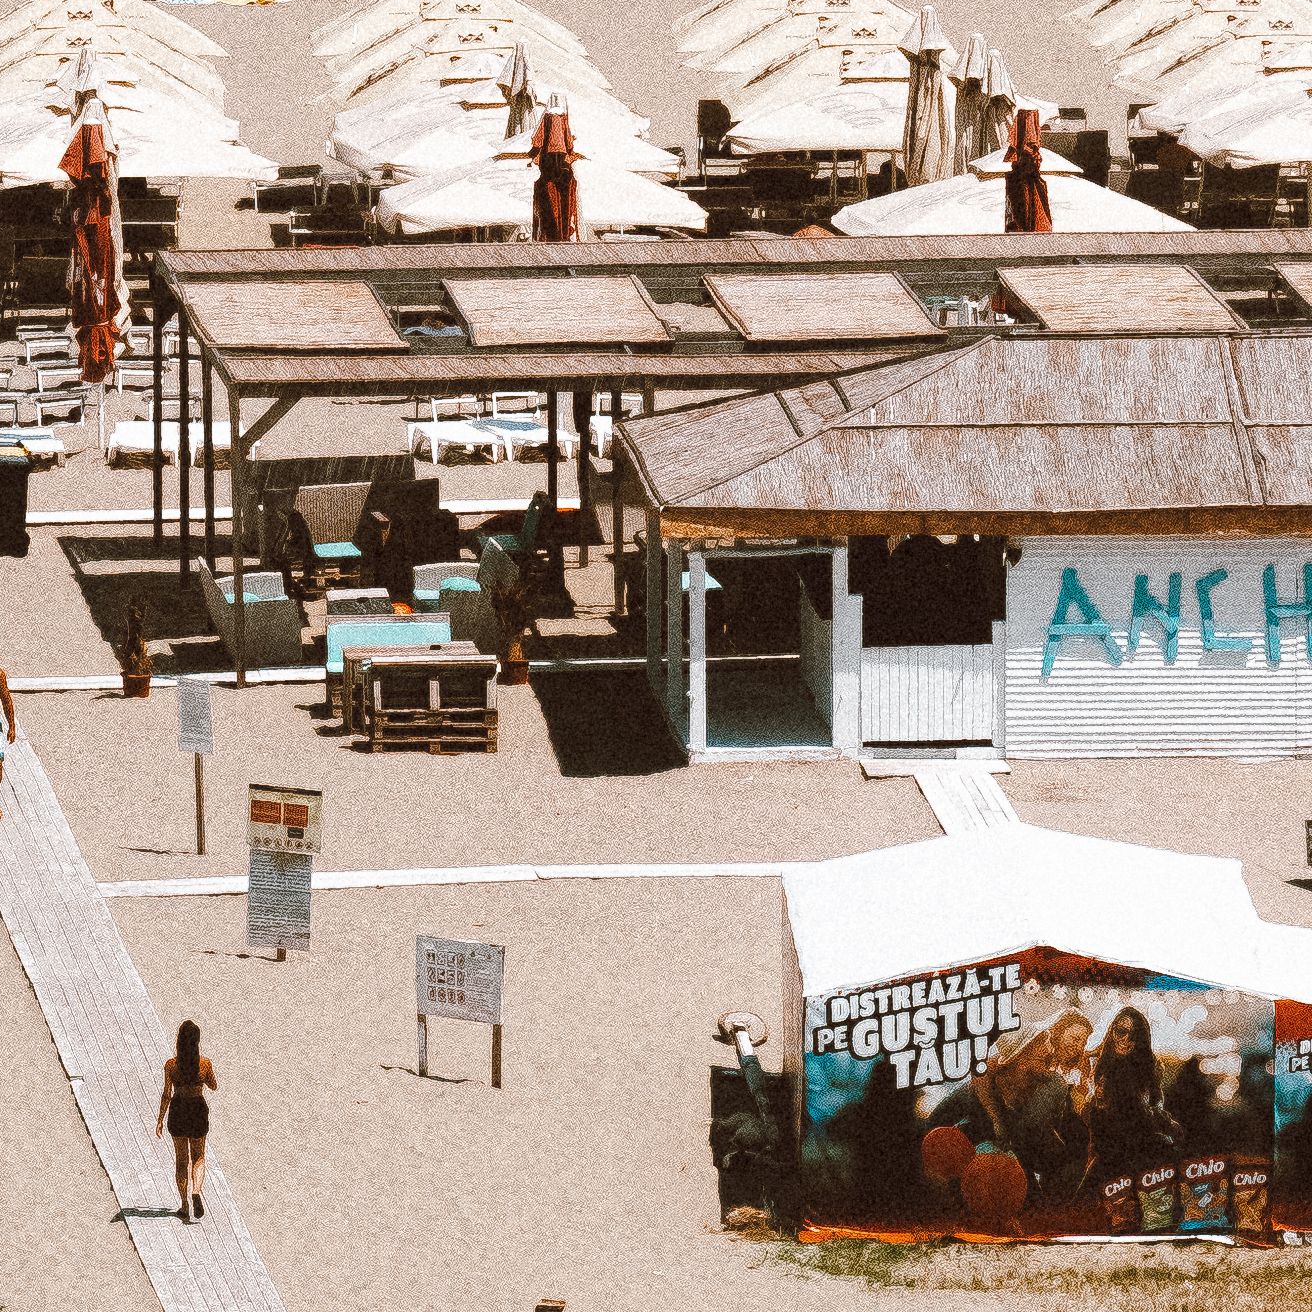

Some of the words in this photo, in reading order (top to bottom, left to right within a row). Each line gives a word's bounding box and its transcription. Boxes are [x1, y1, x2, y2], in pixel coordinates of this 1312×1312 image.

[817, 1026, 848, 1052] PE
[851, 991, 1021, 1058] GUSTUL
[890, 1035, 988, 1089] TĂU!
[1141, 1168, 1174, 1186] Chio
[1186, 1159, 1224, 1178] Chio
[1233, 1172, 1266, 1185] Chio
